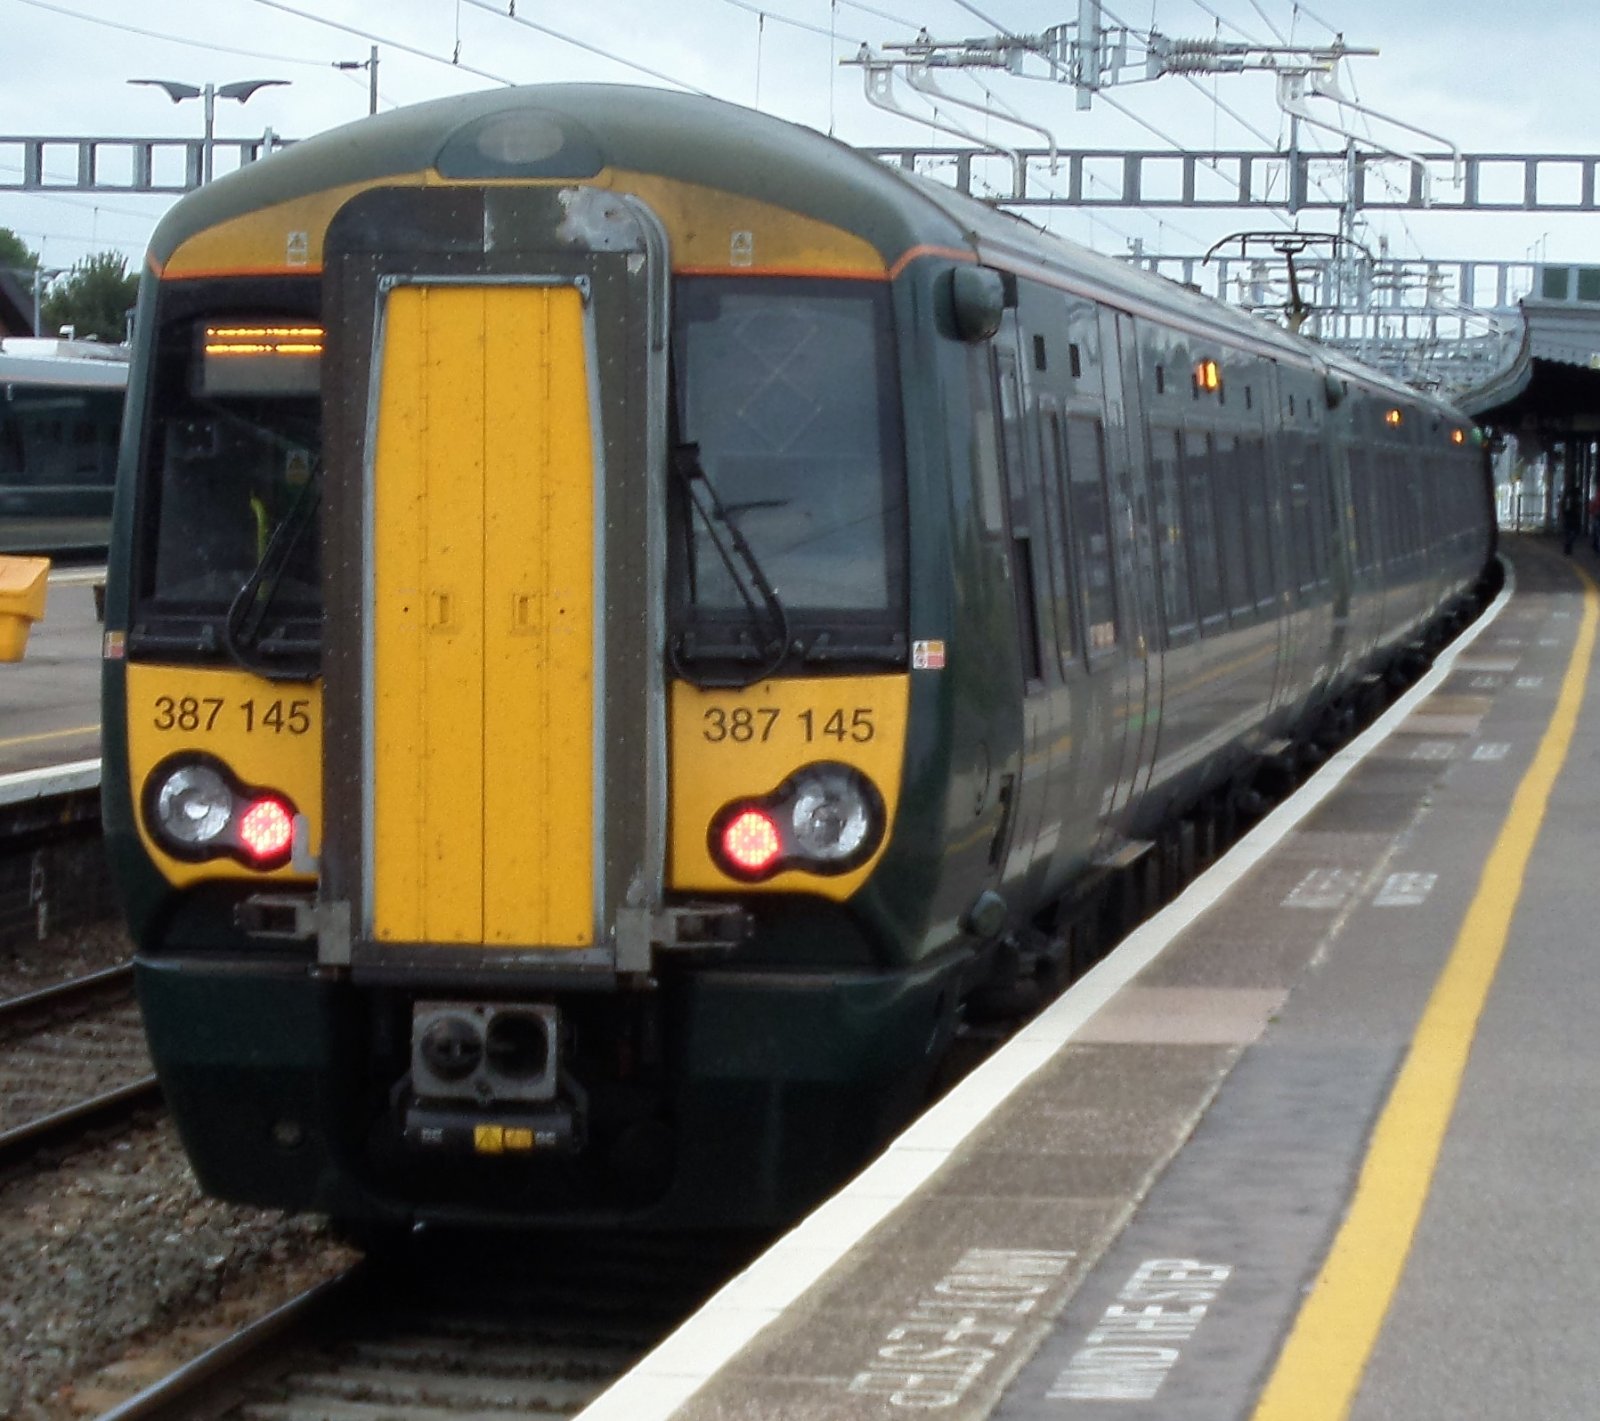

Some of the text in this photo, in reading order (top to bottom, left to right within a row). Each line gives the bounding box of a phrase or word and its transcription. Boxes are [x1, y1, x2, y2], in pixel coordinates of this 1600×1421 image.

[154, 696, 310, 734] 387 145
[703, 708, 875, 743] 387 145
